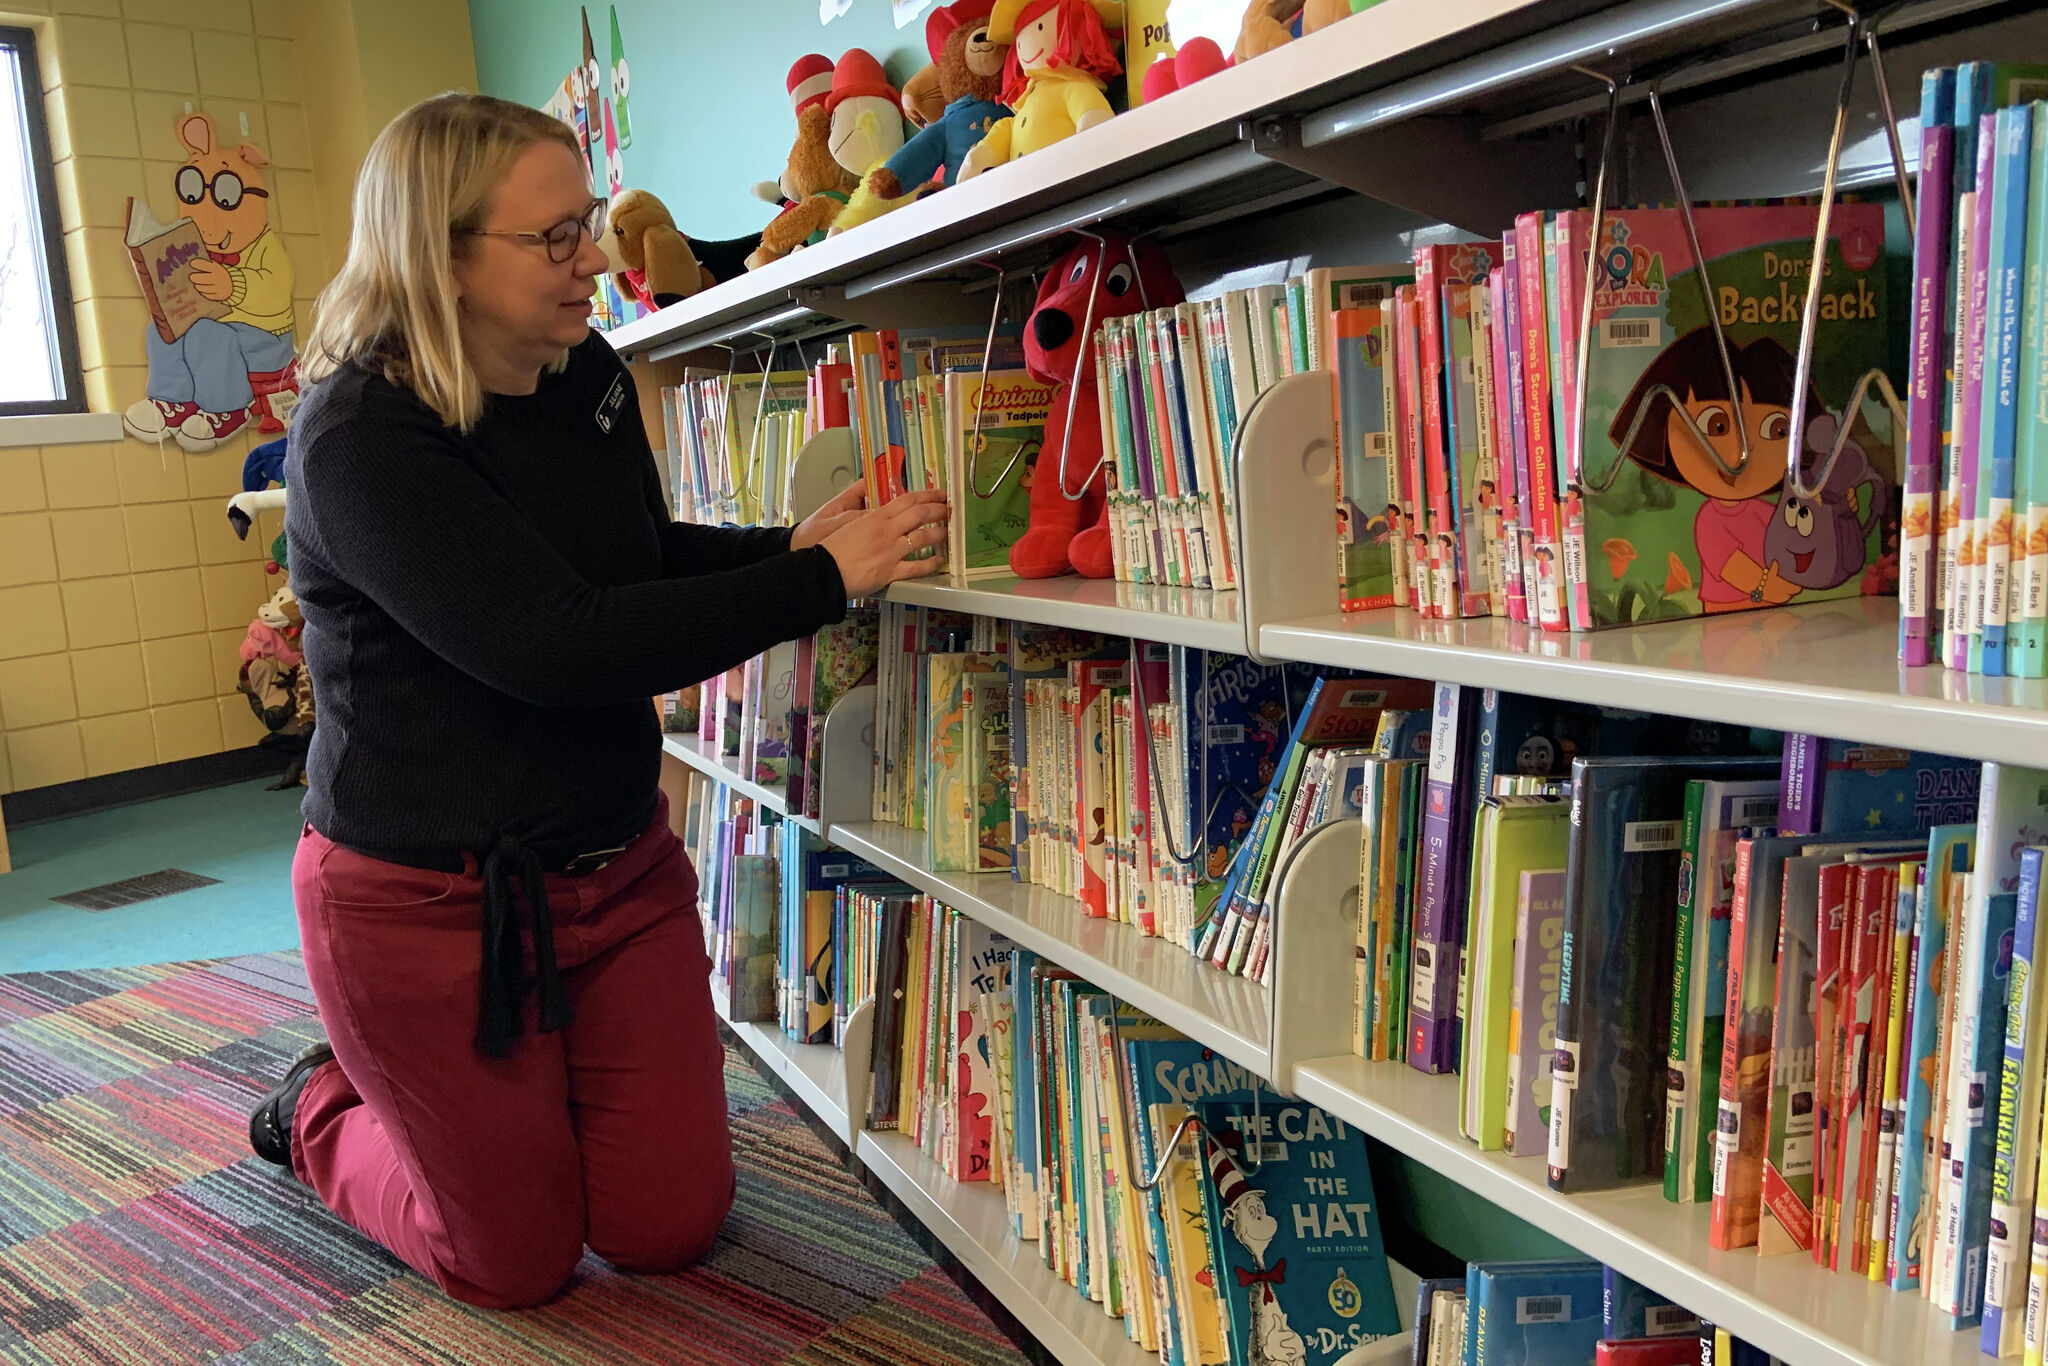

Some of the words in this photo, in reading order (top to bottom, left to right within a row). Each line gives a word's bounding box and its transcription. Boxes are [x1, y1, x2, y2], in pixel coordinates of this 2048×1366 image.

[1583, 245, 1666, 292] DORA
[1763, 251, 1832, 280] Dors
[1921, 277, 1931, 298] How
[2005, 267, 2016, 297] Where
[1595, 290, 1658, 308] EXPLORER
[1718, 278, 1877, 327] Backack
[1920, 298, 1930, 314] Did
[2004, 298, 2015, 316] Did
[1919, 314, 1929, 331] You
[1955, 299, 1965, 361] SOMEONE'S
[1528, 329, 1539, 369] Dora's
[1918, 332, 1929, 355] Make
[2002, 335, 2012, 356] Rain
[942, 356, 987, 367] Cliffor
[2000, 357, 2013, 392] Puddle
[971, 383, 1049, 411] Curious
[1953, 362, 1964, 404] FIBBING
[1006, 410, 1049, 423] Tadpole
[1530, 372, 1542, 441] Storytime
[1534, 446, 1545, 512] Collection
[1572, 550, 1581, 583] Willson
[1908, 551, 1918, 564] JE
[1994, 562, 2004, 575] JE
[1908, 566, 1918, 613] Anastasio
[2030, 570, 2041, 583] JE
[1360, 598, 1393, 608] SCHOL
[1990, 577, 2003, 615] Bentley
[2029, 584, 2040, 610] Berk
[1956, 594, 1968, 631] Bentley
[1433, 722, 1449, 751] Peppa
[1433, 754, 1447, 771] Pig
[1798, 734, 1806, 771] DANIEL
[1786, 733, 1799, 810] NEIGHBORHOOD
[1917, 768, 1982, 799] DAN
[1793, 772, 1805, 812] TIGER'S
[1289, 803, 1301, 826] Tricked
[1914, 802, 1978, 830] TIGE
[1256, 853, 1268, 883] TROUBLE
[1425, 836, 1442, 893] 5-Minute
[1737, 851, 1748, 887] DAYWALT
[1423, 895, 1435, 927] Peppa
[1735, 896, 1745, 923] MYERS
[2018, 879, 2031, 922] HOWARD
[1674, 914, 1688, 962] Princess
[1560, 930, 1574, 1006] SLEEPYTIME
[1672, 963, 1685, 998] Peppa
[1729, 968, 1739, 997] STAR
[1890, 950, 1899, 989] ULTIMATE
[1907, 973, 1917, 1013] SISTERS!
[1672, 1001, 1681, 1022] and
[1728, 998, 1738, 1029] WARS
[1044, 1004, 1053, 1054] SNEETCHES
[1671, 1024, 1680, 1045] the
[1082, 1044, 1092, 1075] LORAX
[1131, 1062, 1144, 1132] SCRAMBLED
[1140, 1135, 1149, 1167] EGGS
[1997, 1058, 2022, 1157] FRANKEN
[874, 1121, 900, 1130] STEVE
[1226, 1115, 1274, 1137] THE
[1278, 1108, 1347, 1142] CAT
[1554, 1119, 1562, 1147] Brumm
[1310, 1150, 1335, 1169] IN
[1787, 1143, 1797, 1151] JE
[1786, 1160, 1812, 1170] Einhorn
[1304, 1177, 1348, 1196] THE
[1993, 1157, 2014, 1206] CRE
[1291, 1203, 1371, 1239] HAT
[1888, 1201, 1898, 1237] RANDOM
[1947, 1216, 1957, 1245] Hapka
[1306, 1246, 1333, 1254] PARTY
[1336, 1244, 1369, 1253] EDITION
[1886, 1239, 1895, 1269] HOUSE
[1990, 1251, 1998, 1263] JE
[1987, 1264, 1998, 1303] Howard
[2031, 1282, 2039, 1295] JE
[1334, 1290, 1358, 1312] 50
[1602, 1287, 1611, 1325] Schulz
[2027, 1297, 2039, 1343] Howard
[1305, 1334, 1319, 1348] By
[1317, 1327, 1347, 1355] Dr.
[1477, 1306, 1487, 1366] PEANUT
